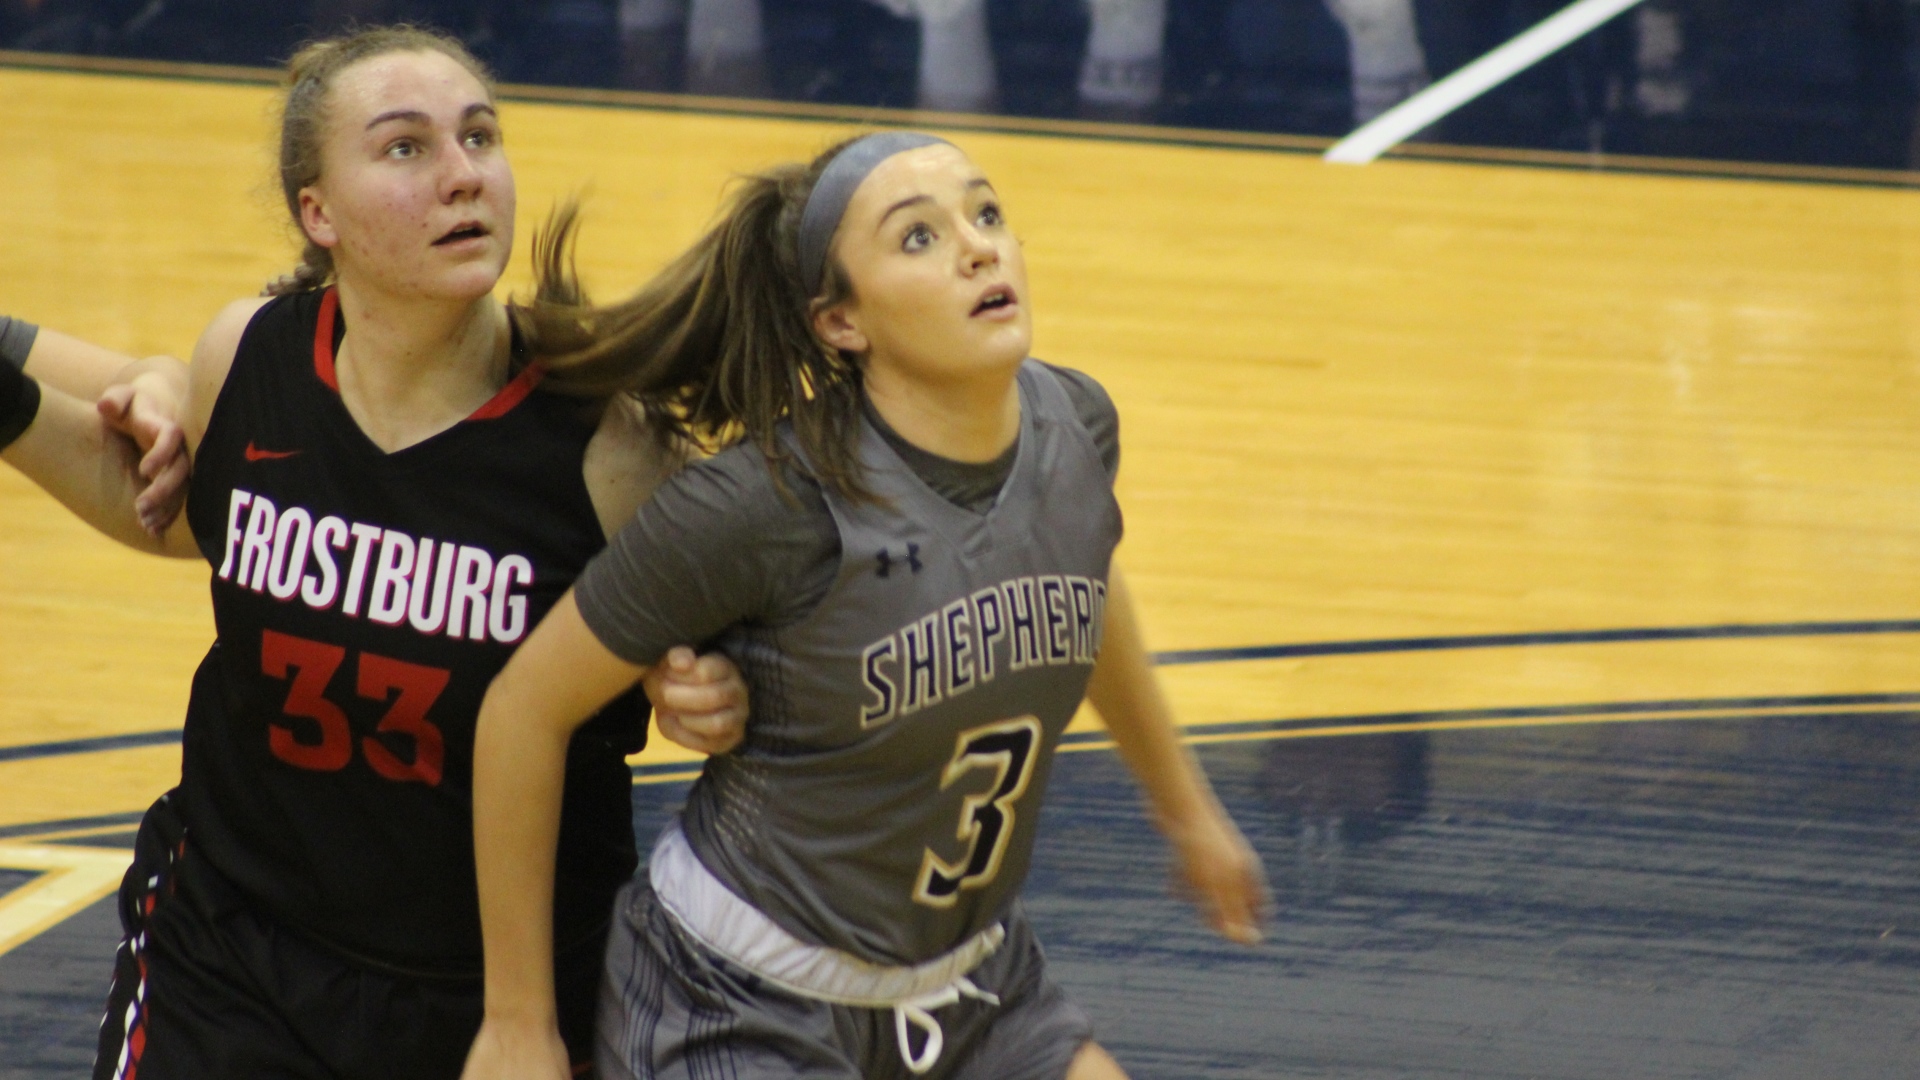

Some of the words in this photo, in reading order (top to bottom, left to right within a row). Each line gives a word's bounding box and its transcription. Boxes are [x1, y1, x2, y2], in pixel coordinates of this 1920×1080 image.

[218, 488, 535, 643] FROSTBURG
[261, 628, 450, 787] 33
[912, 714, 1043, 908] 3
